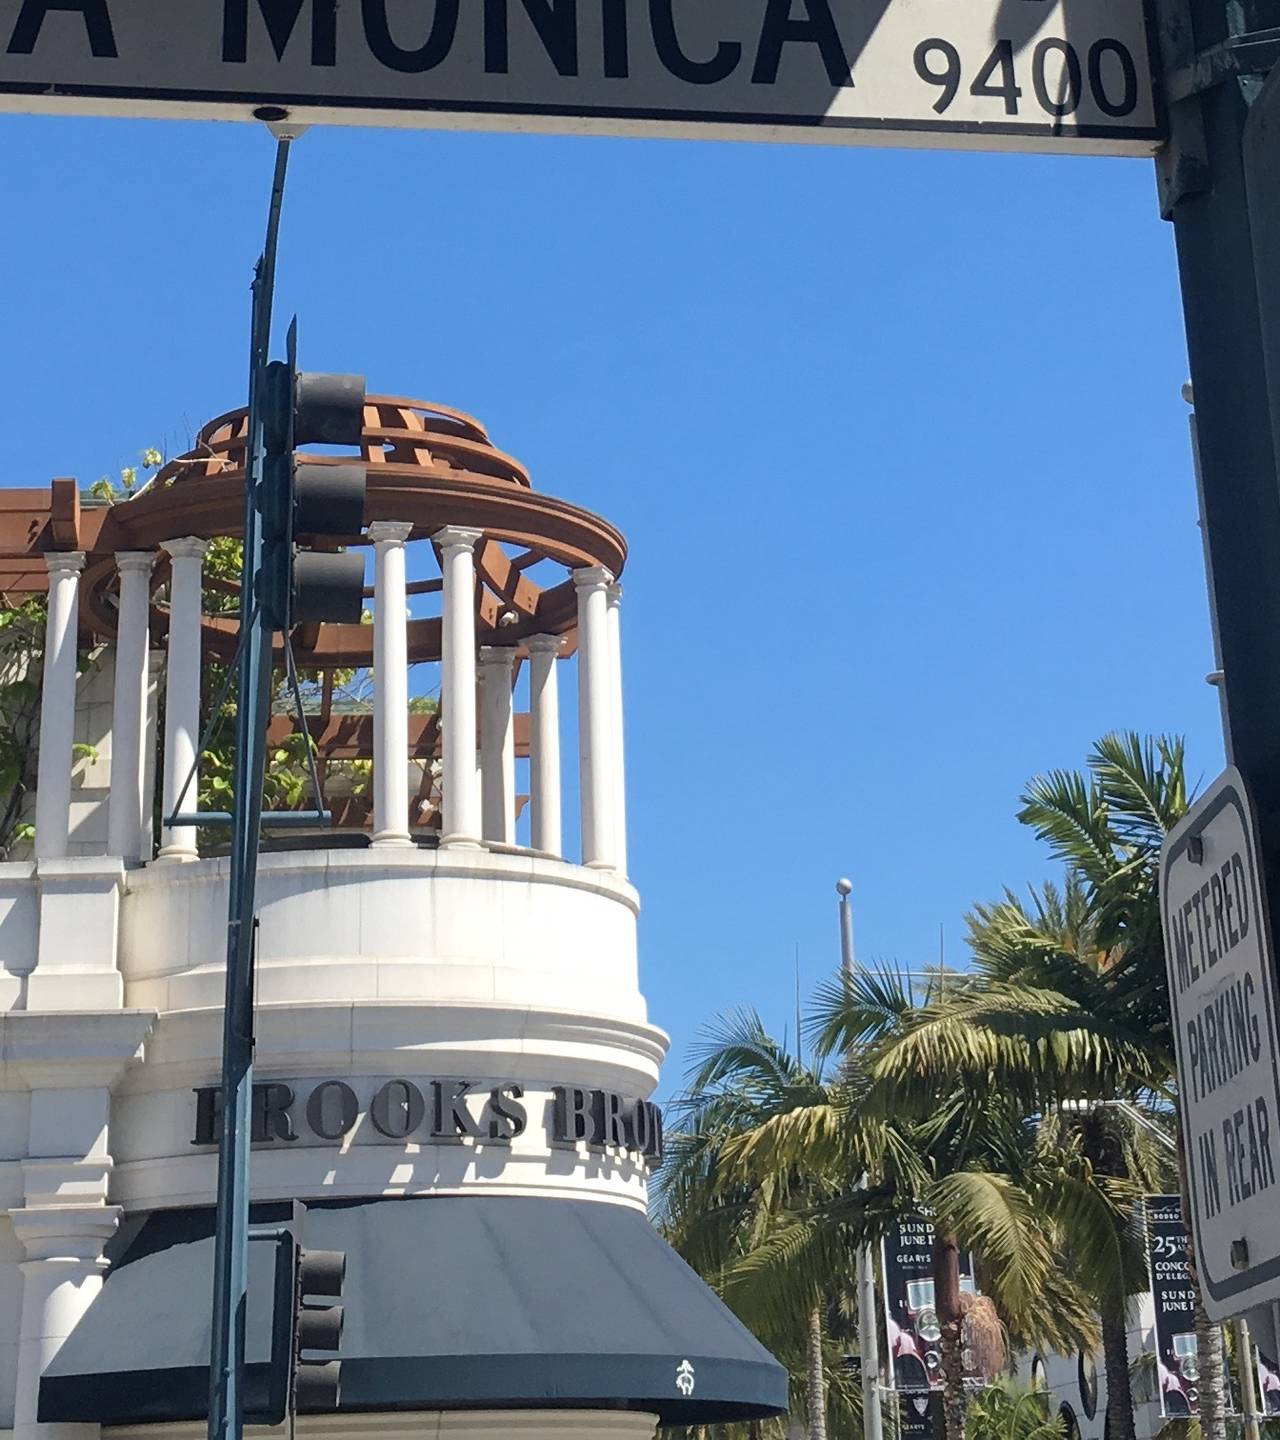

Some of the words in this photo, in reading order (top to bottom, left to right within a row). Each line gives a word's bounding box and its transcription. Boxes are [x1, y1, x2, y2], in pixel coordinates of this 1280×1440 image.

[913, 35, 1138, 116] 9400
[1171, 851, 1250, 995] METERED
[1186, 971, 1262, 1104] PARKING
[1198, 1128, 1220, 1220] IN
[1223, 1095, 1277, 1208] REAR
[896, 1254, 932, 1263] GEARYS
[900, 1235, 927, 1247] JUNE
[1162, 1301, 1188, 1312] JUNE
